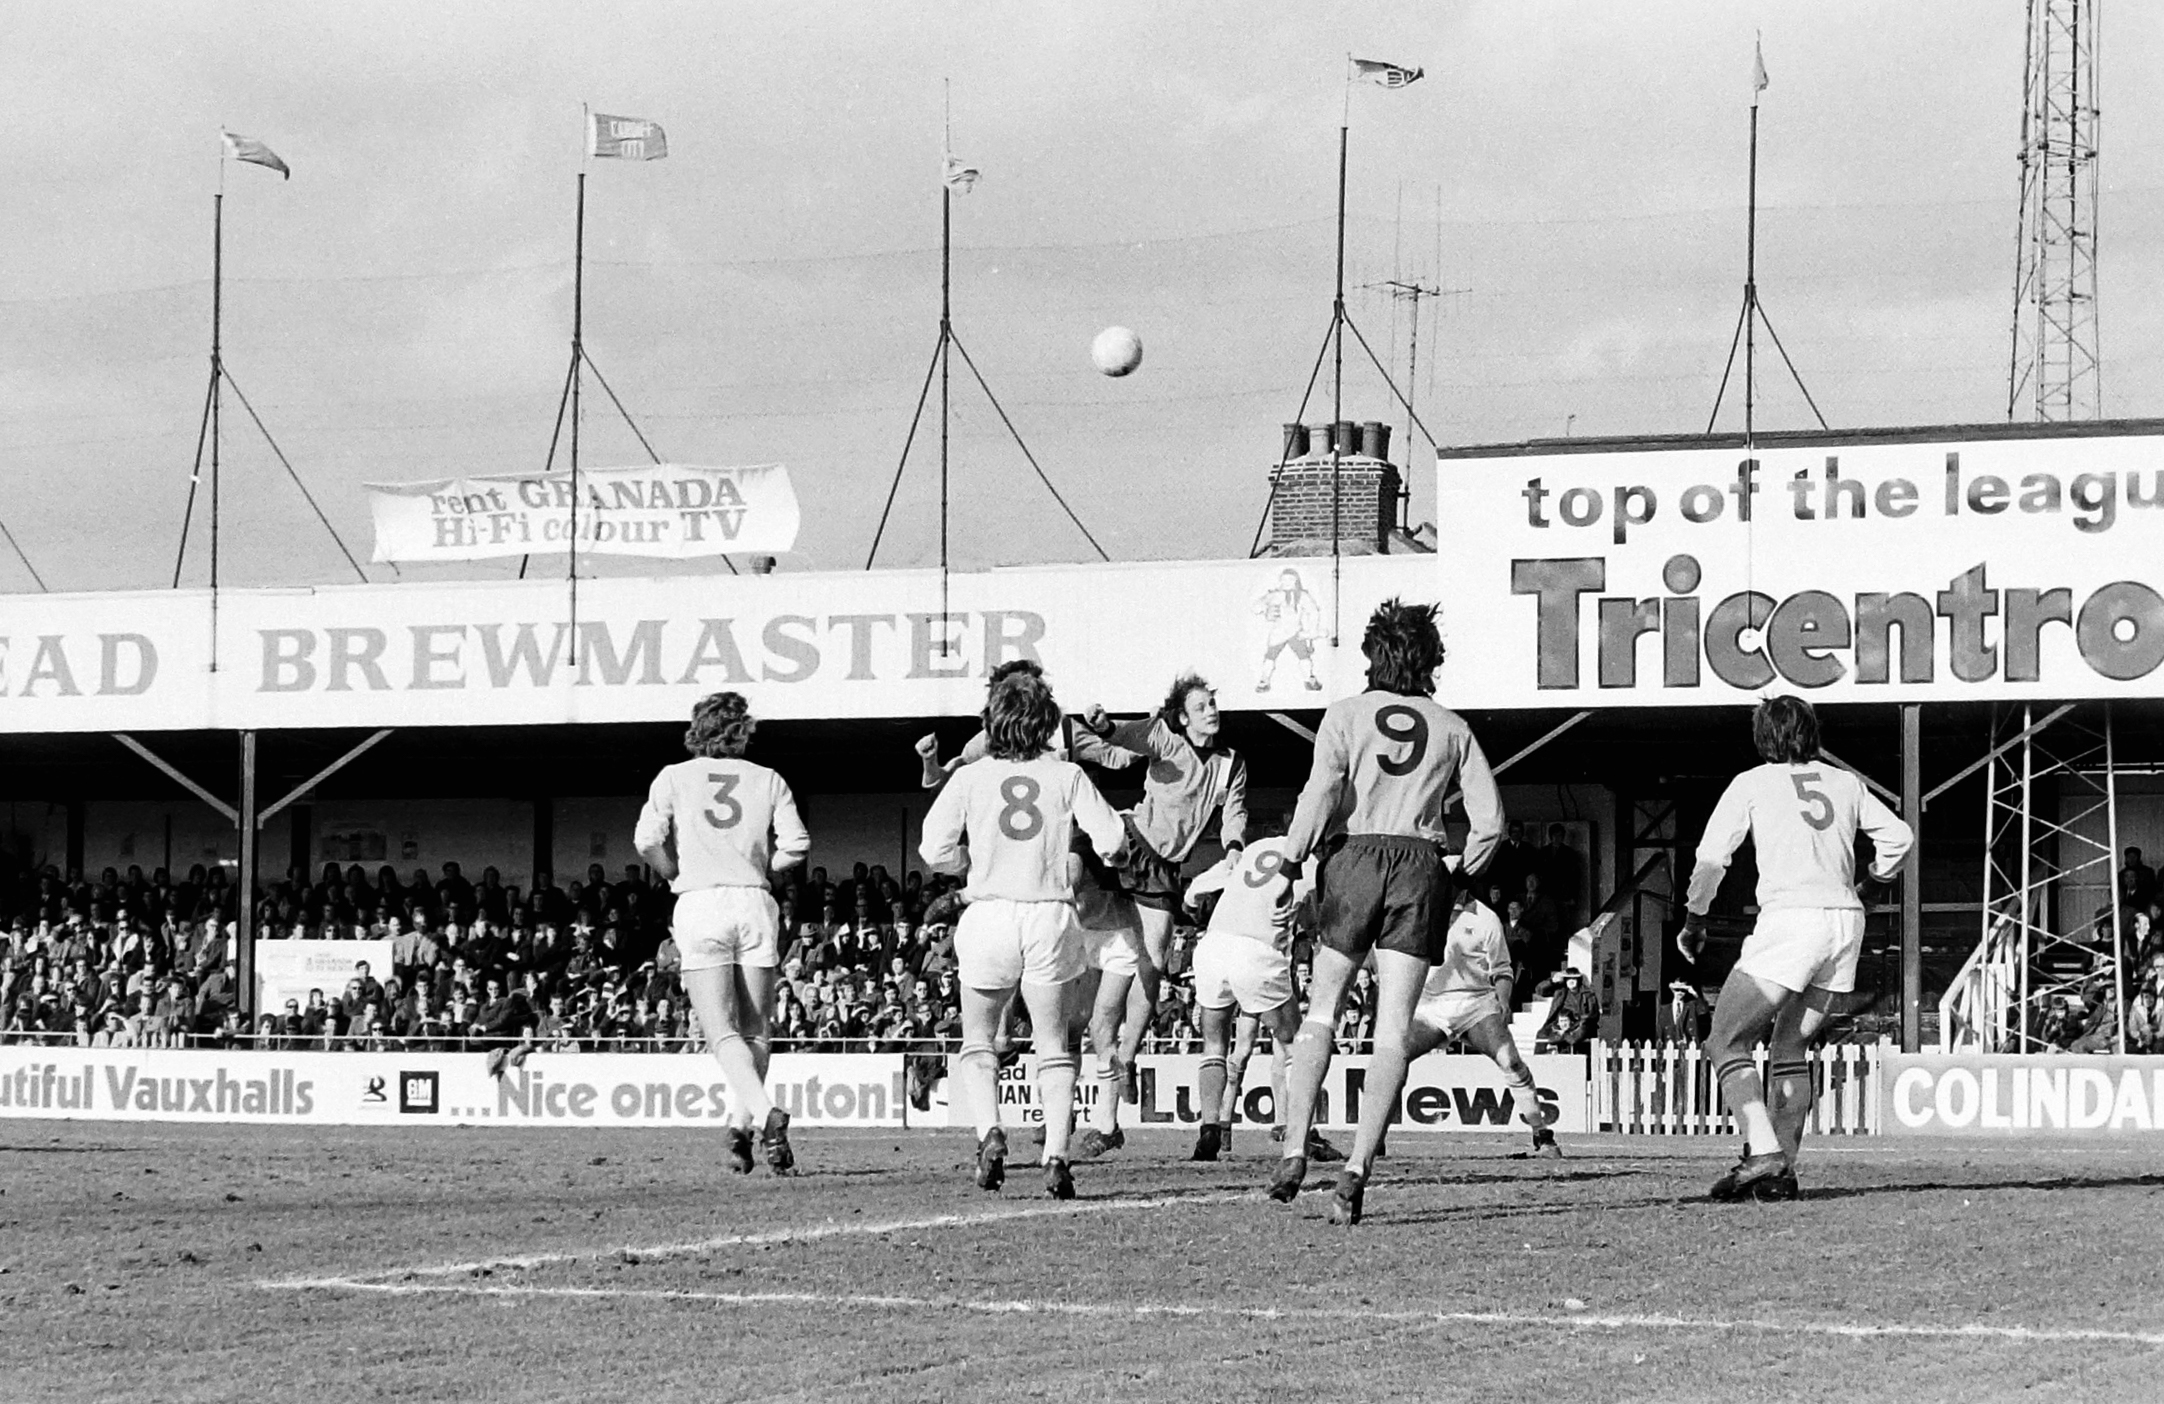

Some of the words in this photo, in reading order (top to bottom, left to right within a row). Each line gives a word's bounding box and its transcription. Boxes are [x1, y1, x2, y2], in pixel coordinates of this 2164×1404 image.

[431, 486, 507, 515] rent
[518, 476, 747, 510] GRANADA
[1521, 477, 1657, 545] top
[1679, 458, 1760, 523] of
[1787, 456, 1919, 520] the
[431, 512, 531, 548] Hi-Fi
[543, 511, 669, 542] colour
[680, 507, 747, 542] TV
[1511, 553, 2164, 691] Tricentro
[256, 611, 1051, 693] BREWMASTER
[1375, 704, 1429, 777] 9
[704, 772, 743, 830] 3
[999, 775, 1044, 841] 8
[1790, 772, 1835, 832] 5
[1244, 850, 1285, 889] 9
[105, 1065, 314, 1115] Vauxhalls
[775, 1071, 904, 1119] uton!
